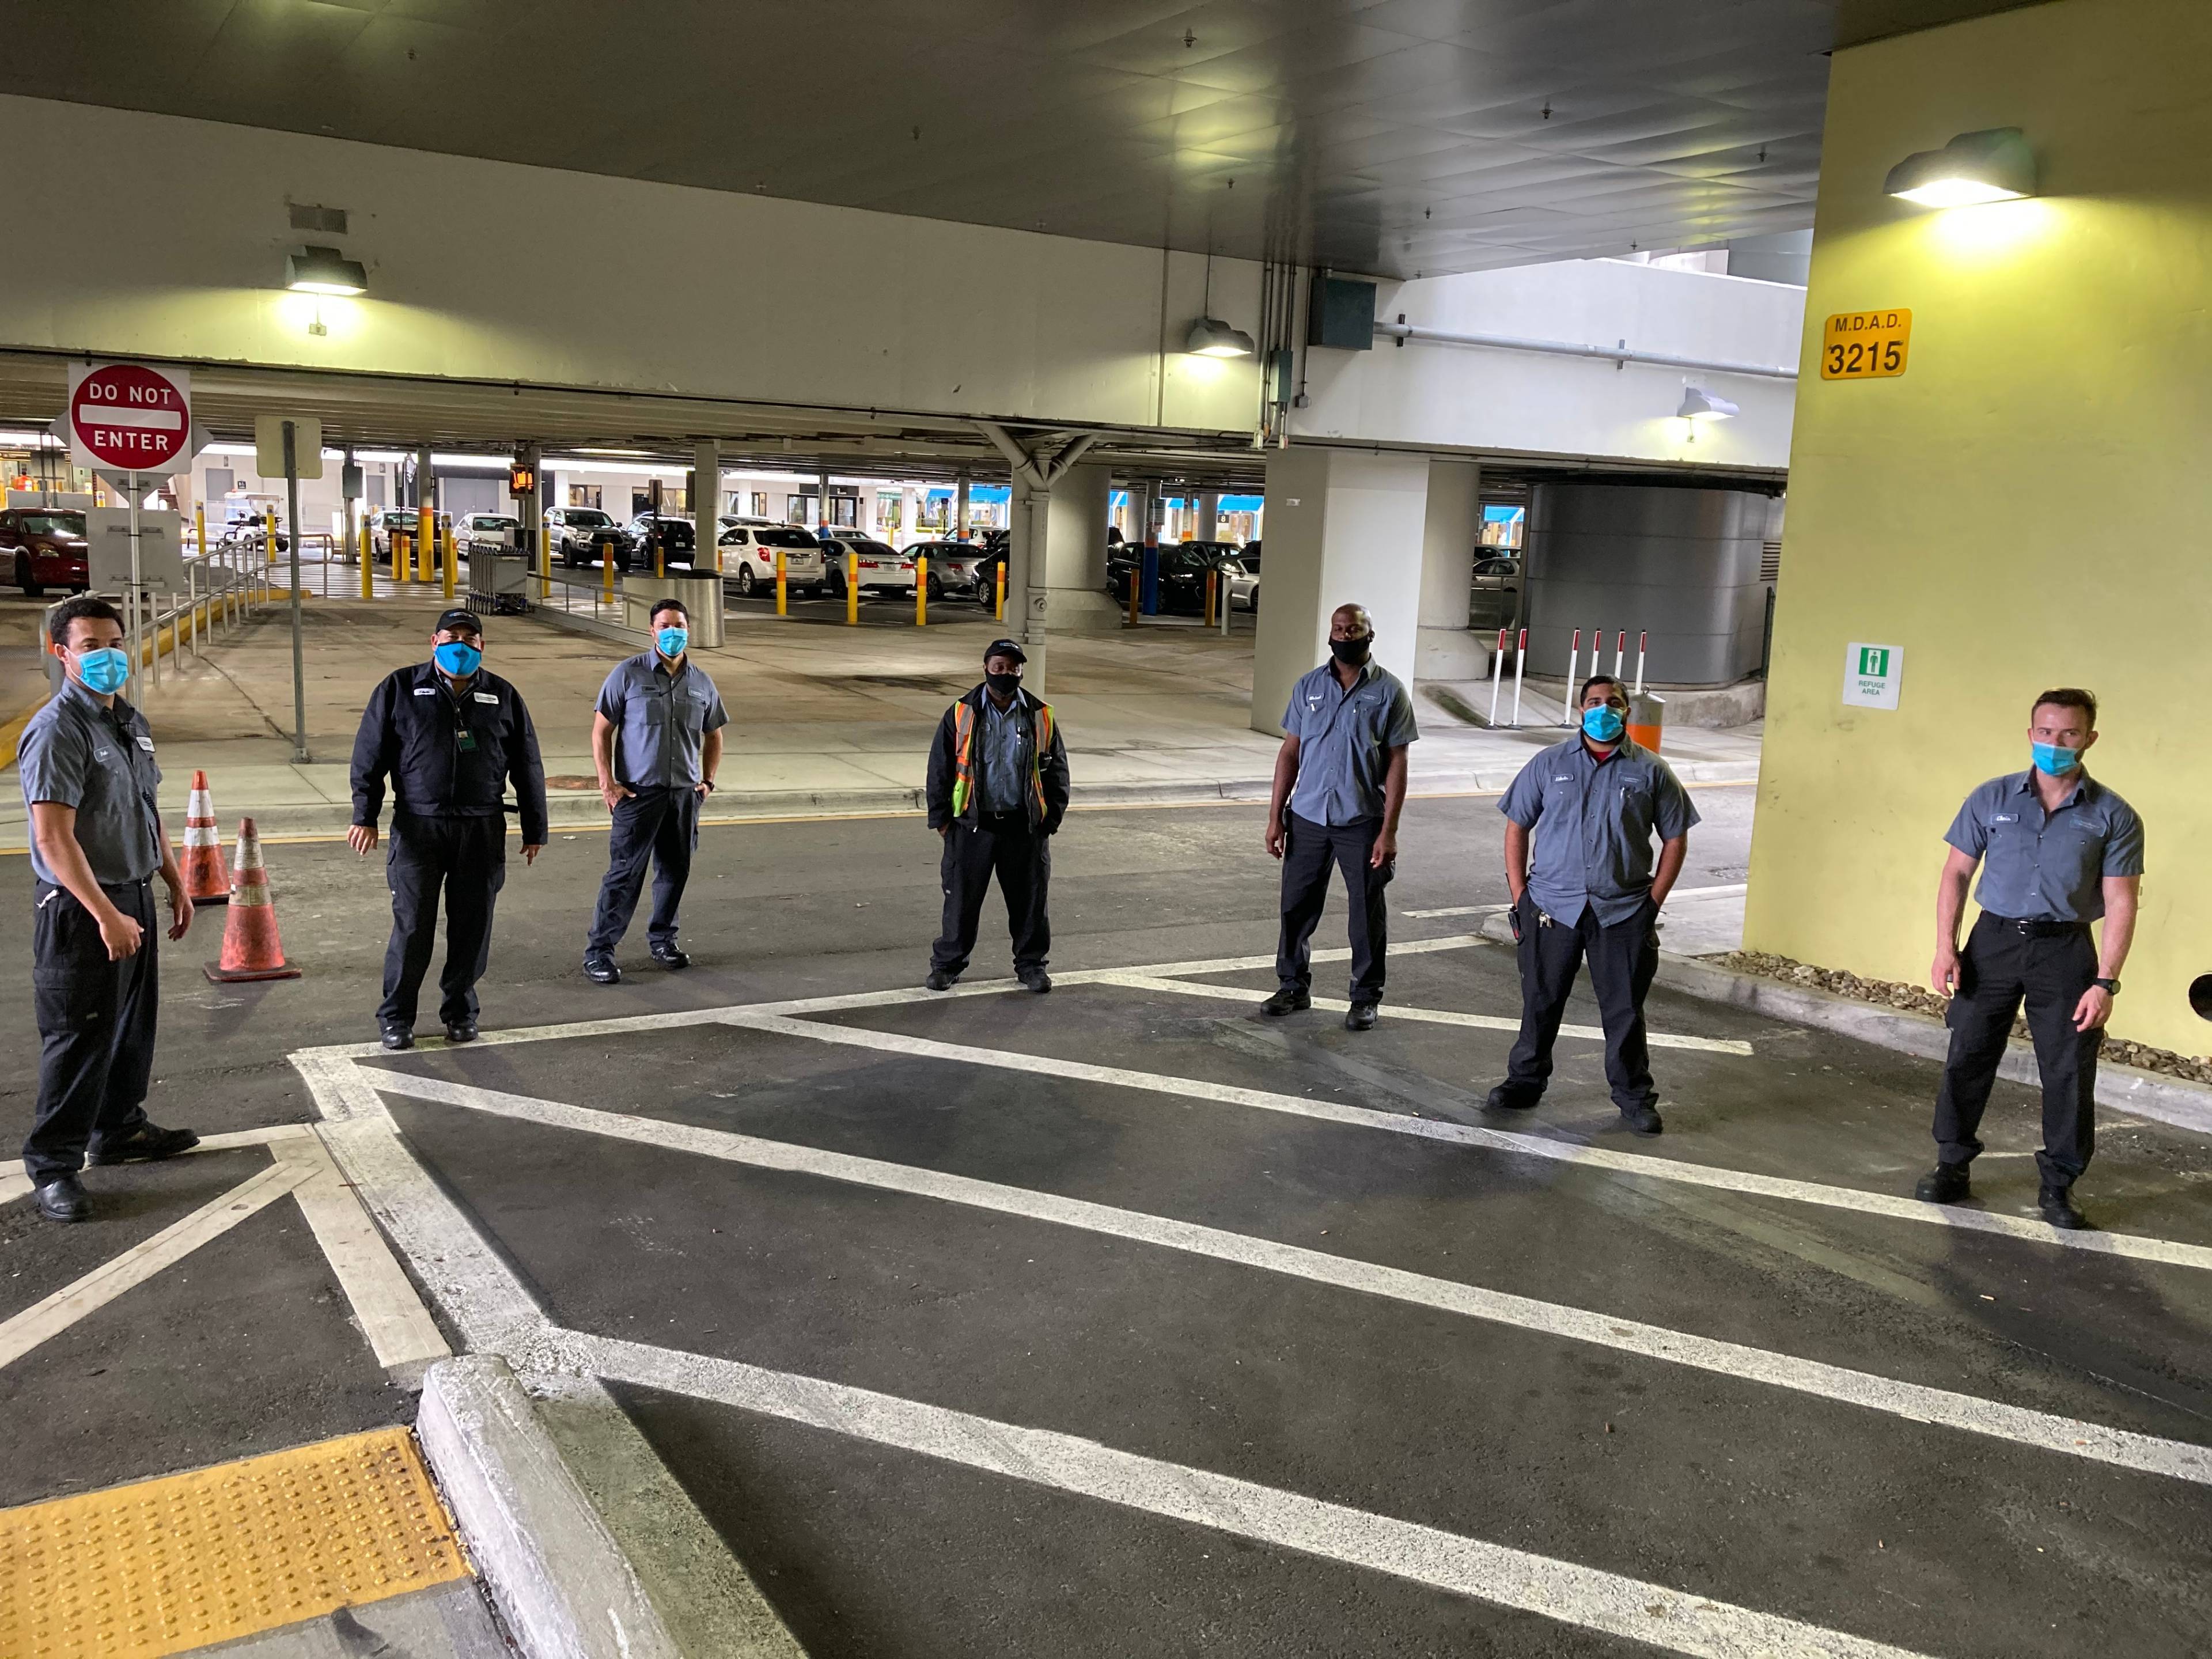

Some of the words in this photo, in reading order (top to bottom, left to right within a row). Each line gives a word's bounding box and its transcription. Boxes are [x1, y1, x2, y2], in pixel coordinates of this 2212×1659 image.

[1835, 313, 1902, 332] M.D.A.D.
[1828, 340, 1903, 374] 3215
[89, 383, 118, 400] DO
[129, 386, 171, 404] NOT
[94, 430, 168, 451] ENTER
[1858, 680, 1885, 688] REFUGE
[1862, 688, 1880, 696] AREA
